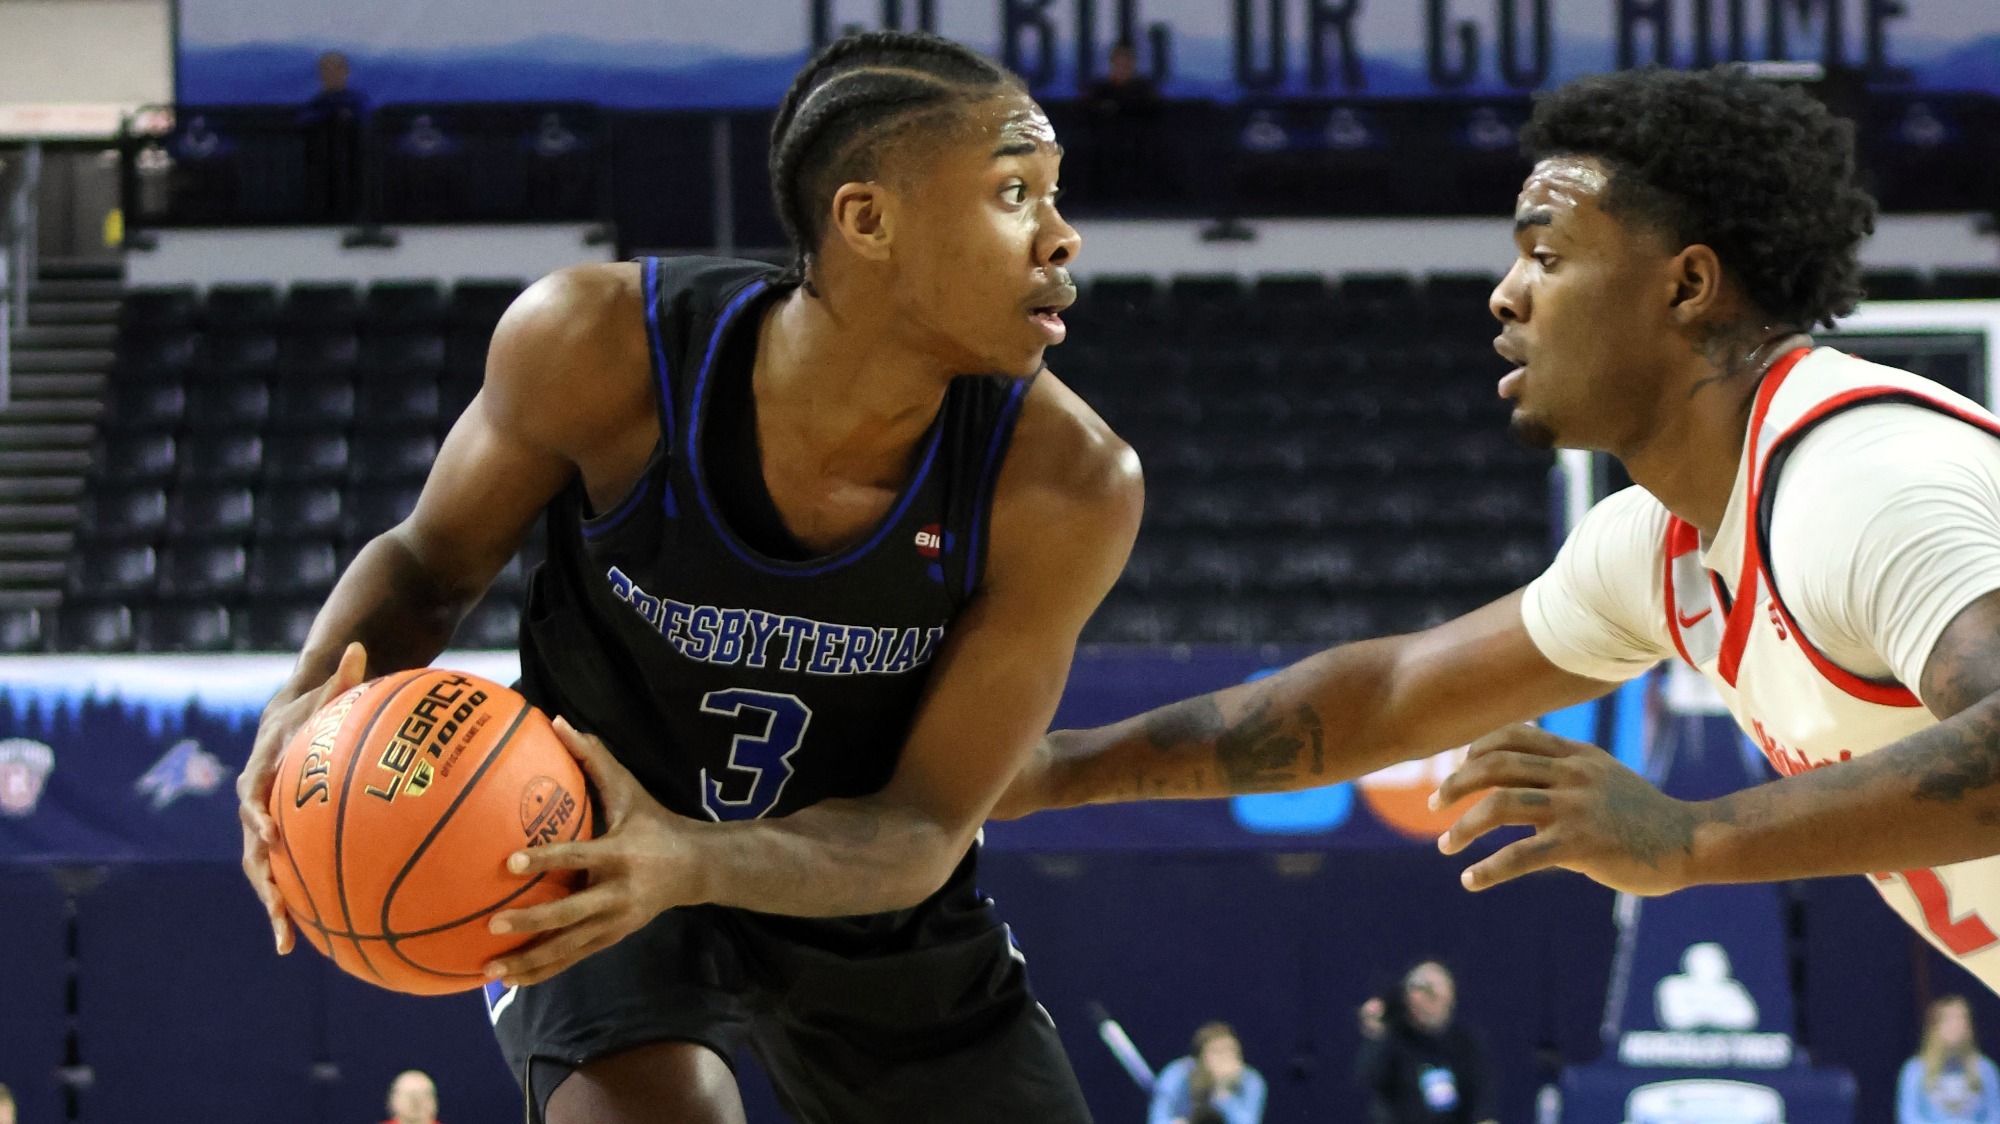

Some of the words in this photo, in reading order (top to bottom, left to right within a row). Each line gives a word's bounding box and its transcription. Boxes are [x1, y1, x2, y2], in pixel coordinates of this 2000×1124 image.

[914, 531, 941, 549] BI
[365, 674, 472, 803] LEGACY
[427, 690, 488, 759] 1000
[700, 687, 813, 822] 3
